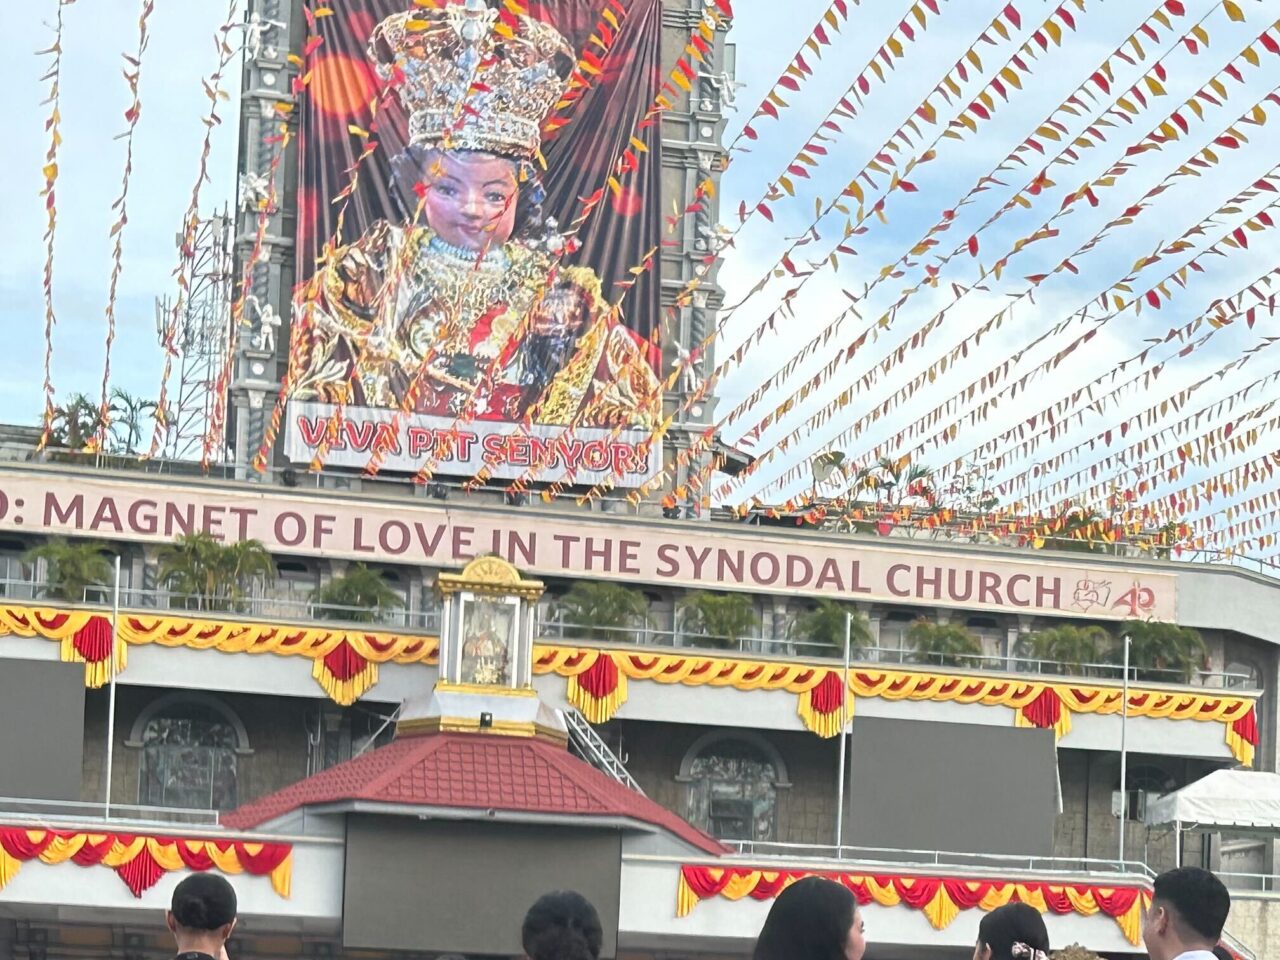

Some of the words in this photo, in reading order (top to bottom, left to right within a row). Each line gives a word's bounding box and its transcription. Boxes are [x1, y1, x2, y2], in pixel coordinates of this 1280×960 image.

[297, 416, 401, 455] VIVA
[408, 427, 477, 462] PIT
[482, 432, 650, 476] SENYOR!
[43, 491, 258, 541] MAGNET
[273, 511, 337, 549] OF
[353, 517, 475, 561] LOVE
[492, 529, 537, 566] IN
[553, 534, 641, 574] THE
[656, 543, 871, 593] SYNODAL
[886, 563, 1062, 609] CHURCH
